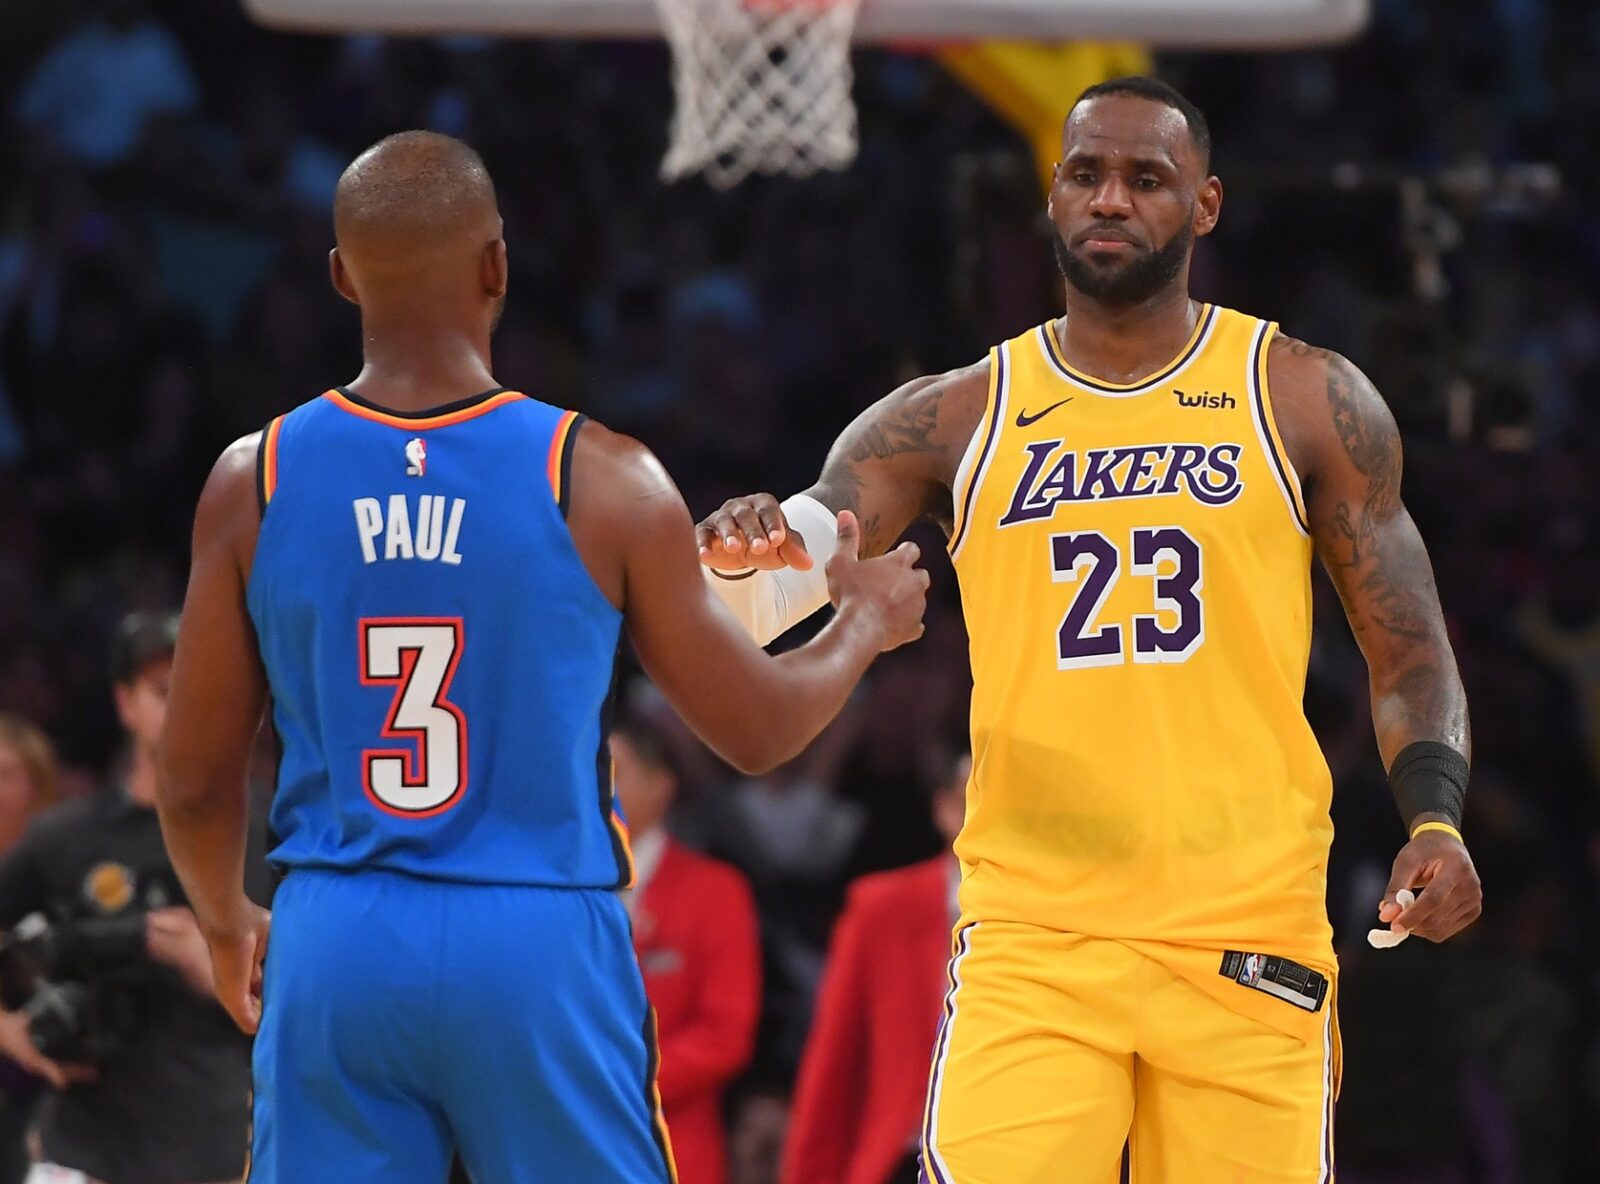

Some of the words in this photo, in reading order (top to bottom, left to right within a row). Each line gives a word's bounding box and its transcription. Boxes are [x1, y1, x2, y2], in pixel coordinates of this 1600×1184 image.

[1173, 389, 1236, 409] wish
[998, 438, 1244, 528] LAKERS
[353, 494, 466, 564] PAUL
[1049, 525, 1206, 670] 23
[358, 616, 468, 819] 3
